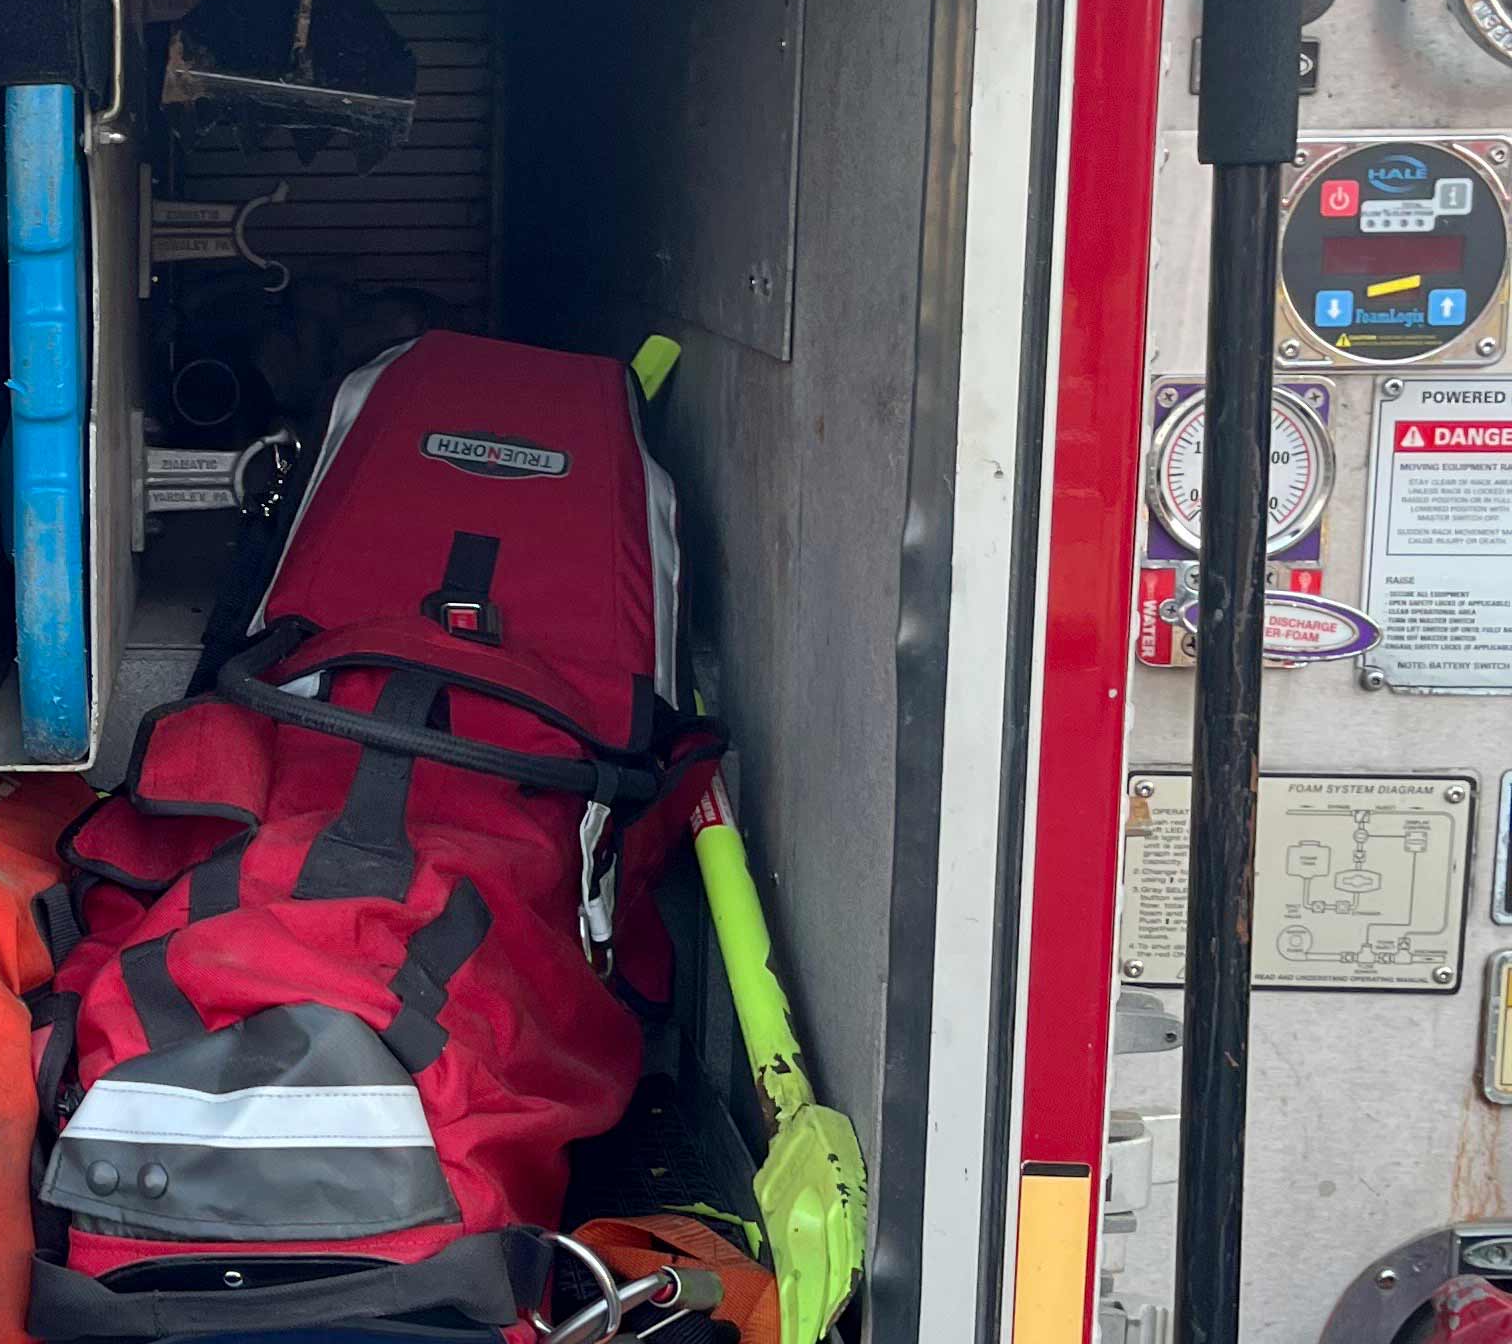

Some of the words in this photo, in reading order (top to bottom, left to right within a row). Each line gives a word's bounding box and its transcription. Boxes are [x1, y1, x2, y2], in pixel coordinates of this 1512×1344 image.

[1368, 168, 1428, 180] HALE
[1421, 391, 1506, 404] POWERED
[438, 438, 553, 469] TRUENORTH
[1141, 599, 1156, 658] WATER
[1269, 616, 1337, 633] DISCHARGE
[1287, 783, 1323, 793] FOAM
[1326, 784, 1375, 794] SYSTEM
[1377, 784, 1435, 795] DIAGRAM
